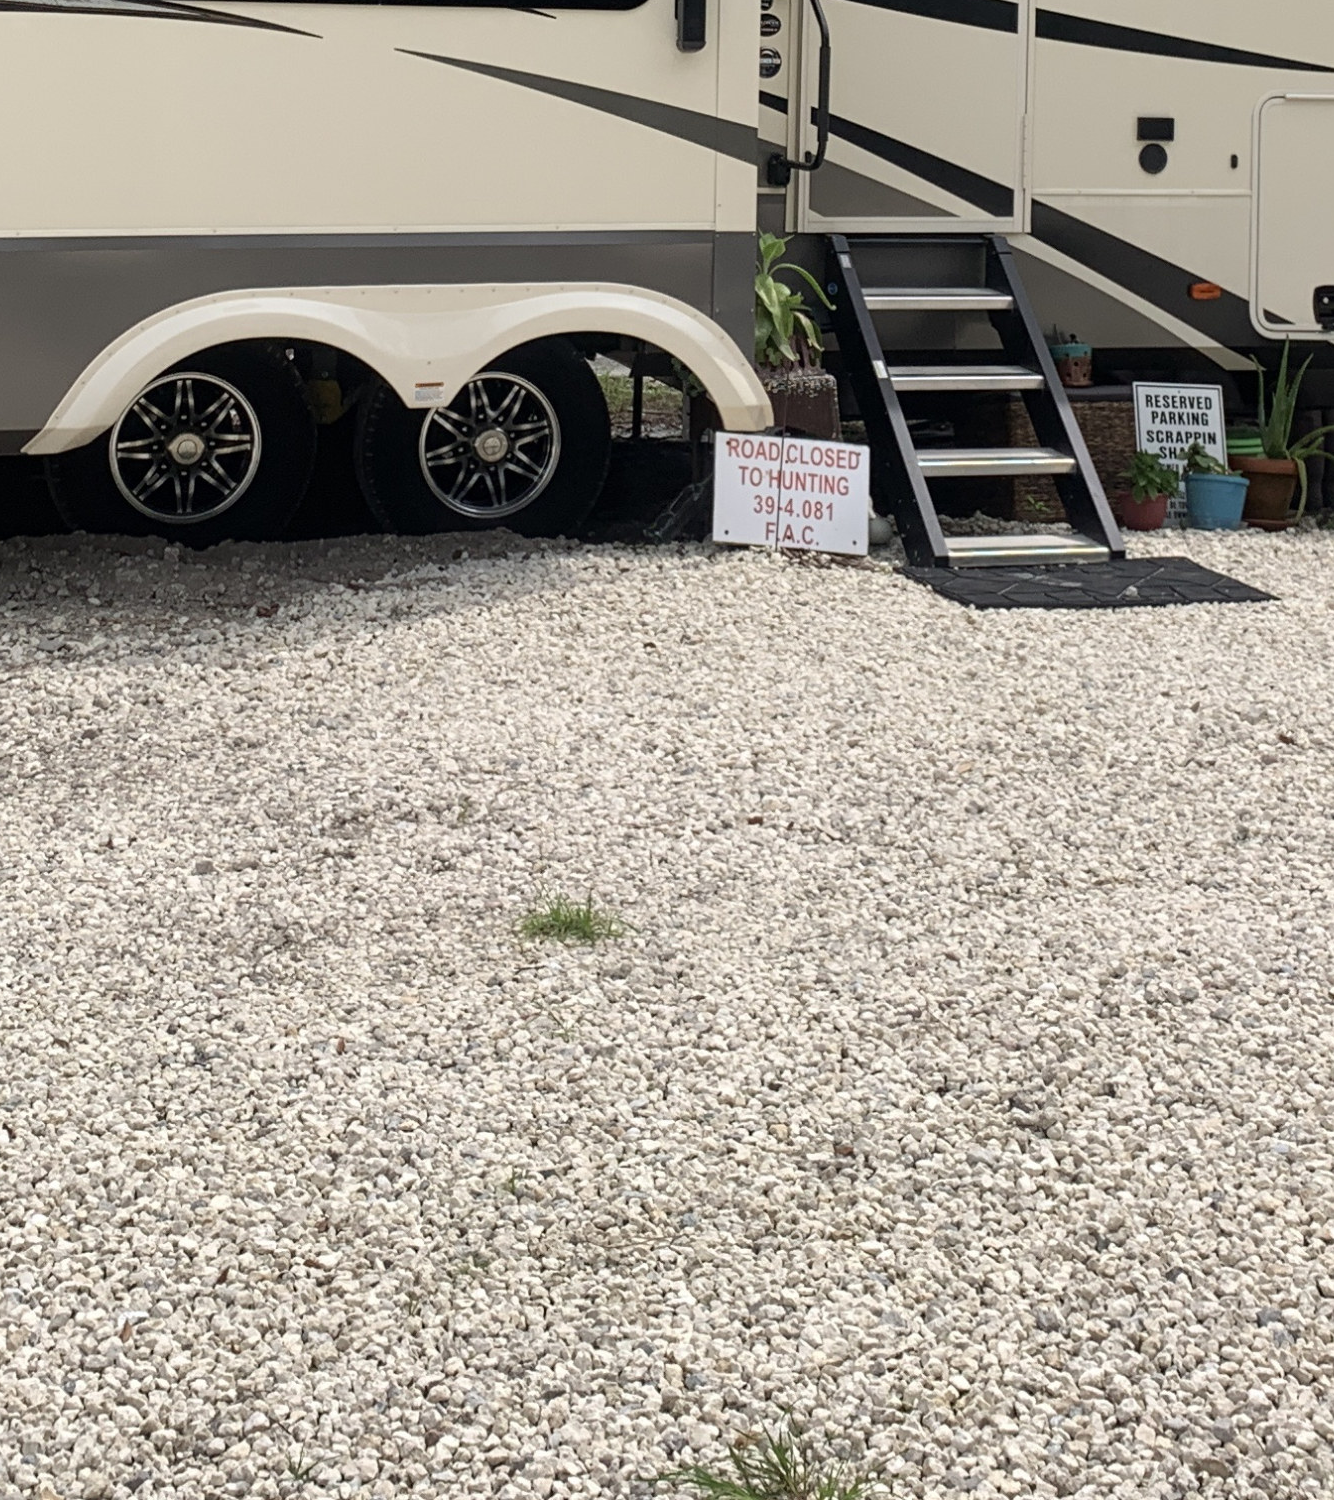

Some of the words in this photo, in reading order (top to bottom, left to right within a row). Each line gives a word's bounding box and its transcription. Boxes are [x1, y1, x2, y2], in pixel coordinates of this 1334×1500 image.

[1145, 394, 1213, 410] RESERVED
[1151, 411, 1209, 427] PARKING
[1146, 430, 1217, 445] SCRAPPIN
[727, 438, 781, 461] ROAD
[786, 444, 860, 470] CLOSED
[738, 466, 763, 487] TO
[768, 470, 850, 496] HUNTING
[753, 495, 834, 521] 39-4.081
[765, 522, 820, 546] F.A.C.
